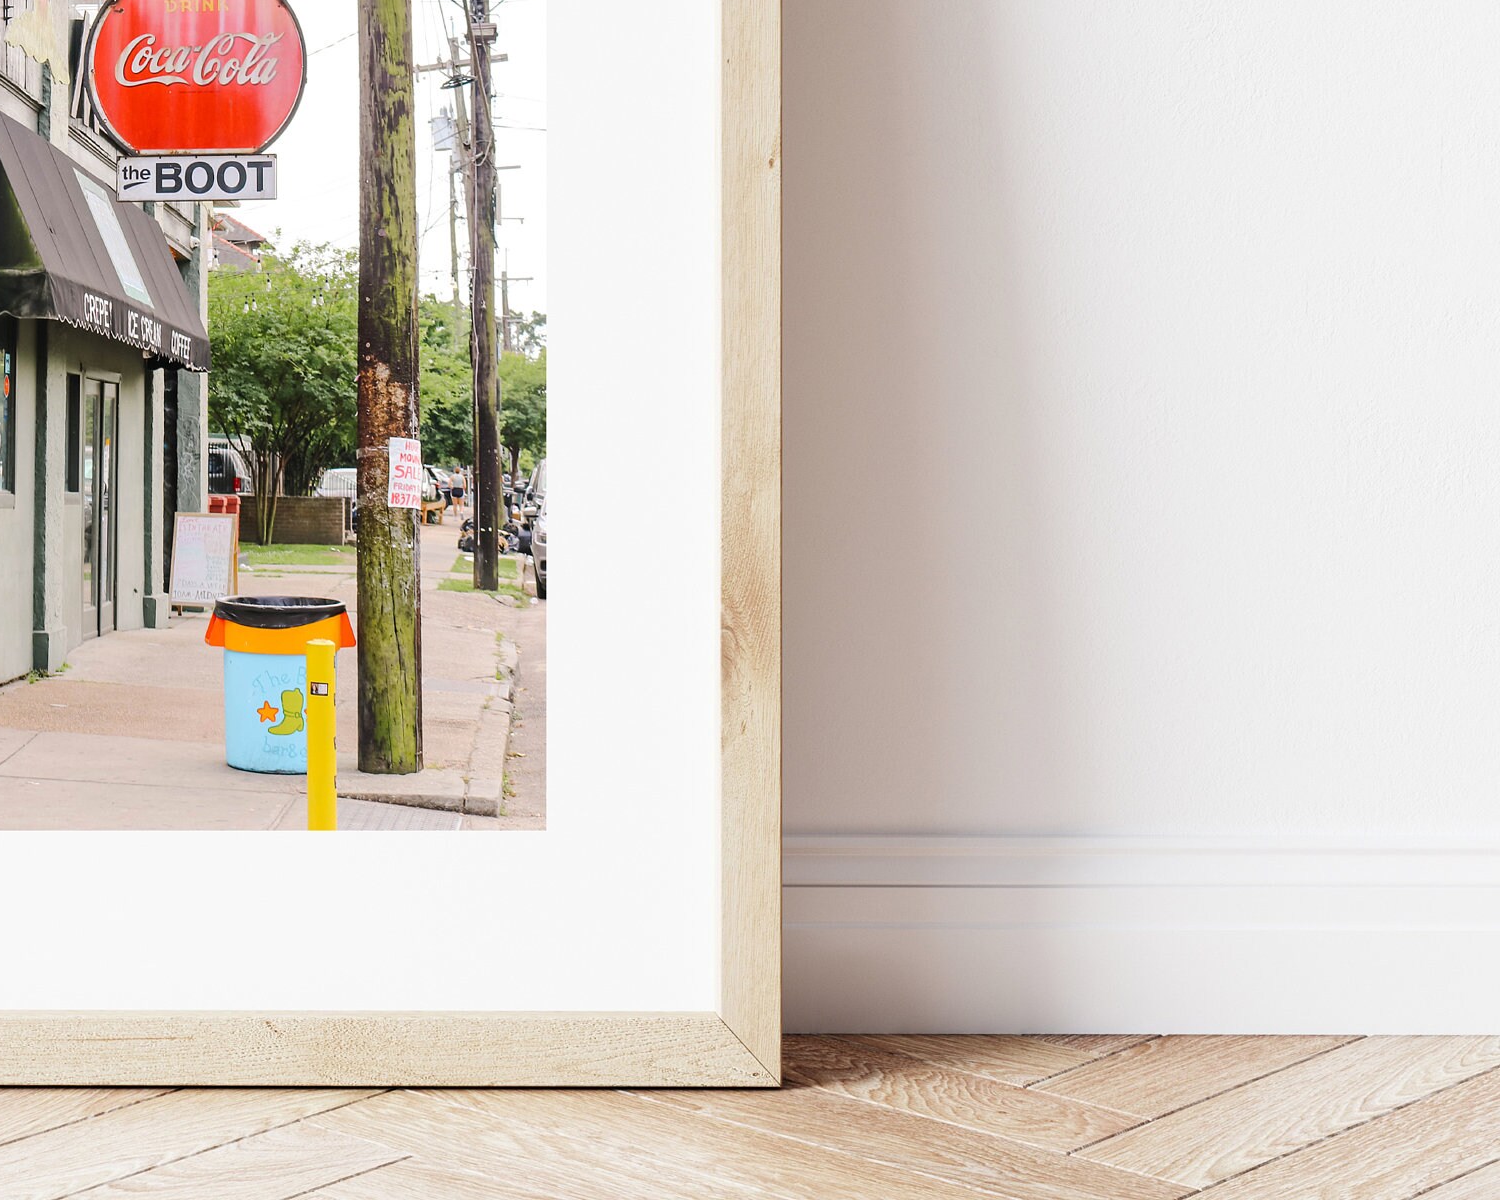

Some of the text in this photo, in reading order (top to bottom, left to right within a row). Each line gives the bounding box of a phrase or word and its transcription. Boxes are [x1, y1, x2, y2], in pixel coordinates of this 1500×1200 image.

[114, 31, 285, 87] Coca-Cola
[122, 161, 273, 194] the BOOT
[127, 309, 139, 339] ICE
[140, 315, 162, 349] CREAM
[170, 329, 191, 360] COFFEE
[394, 465, 420, 481] SALE
[391, 492, 410, 505] 1837
[393, 482, 416, 493] FRIDAY
[252, 669, 291, 695] The
